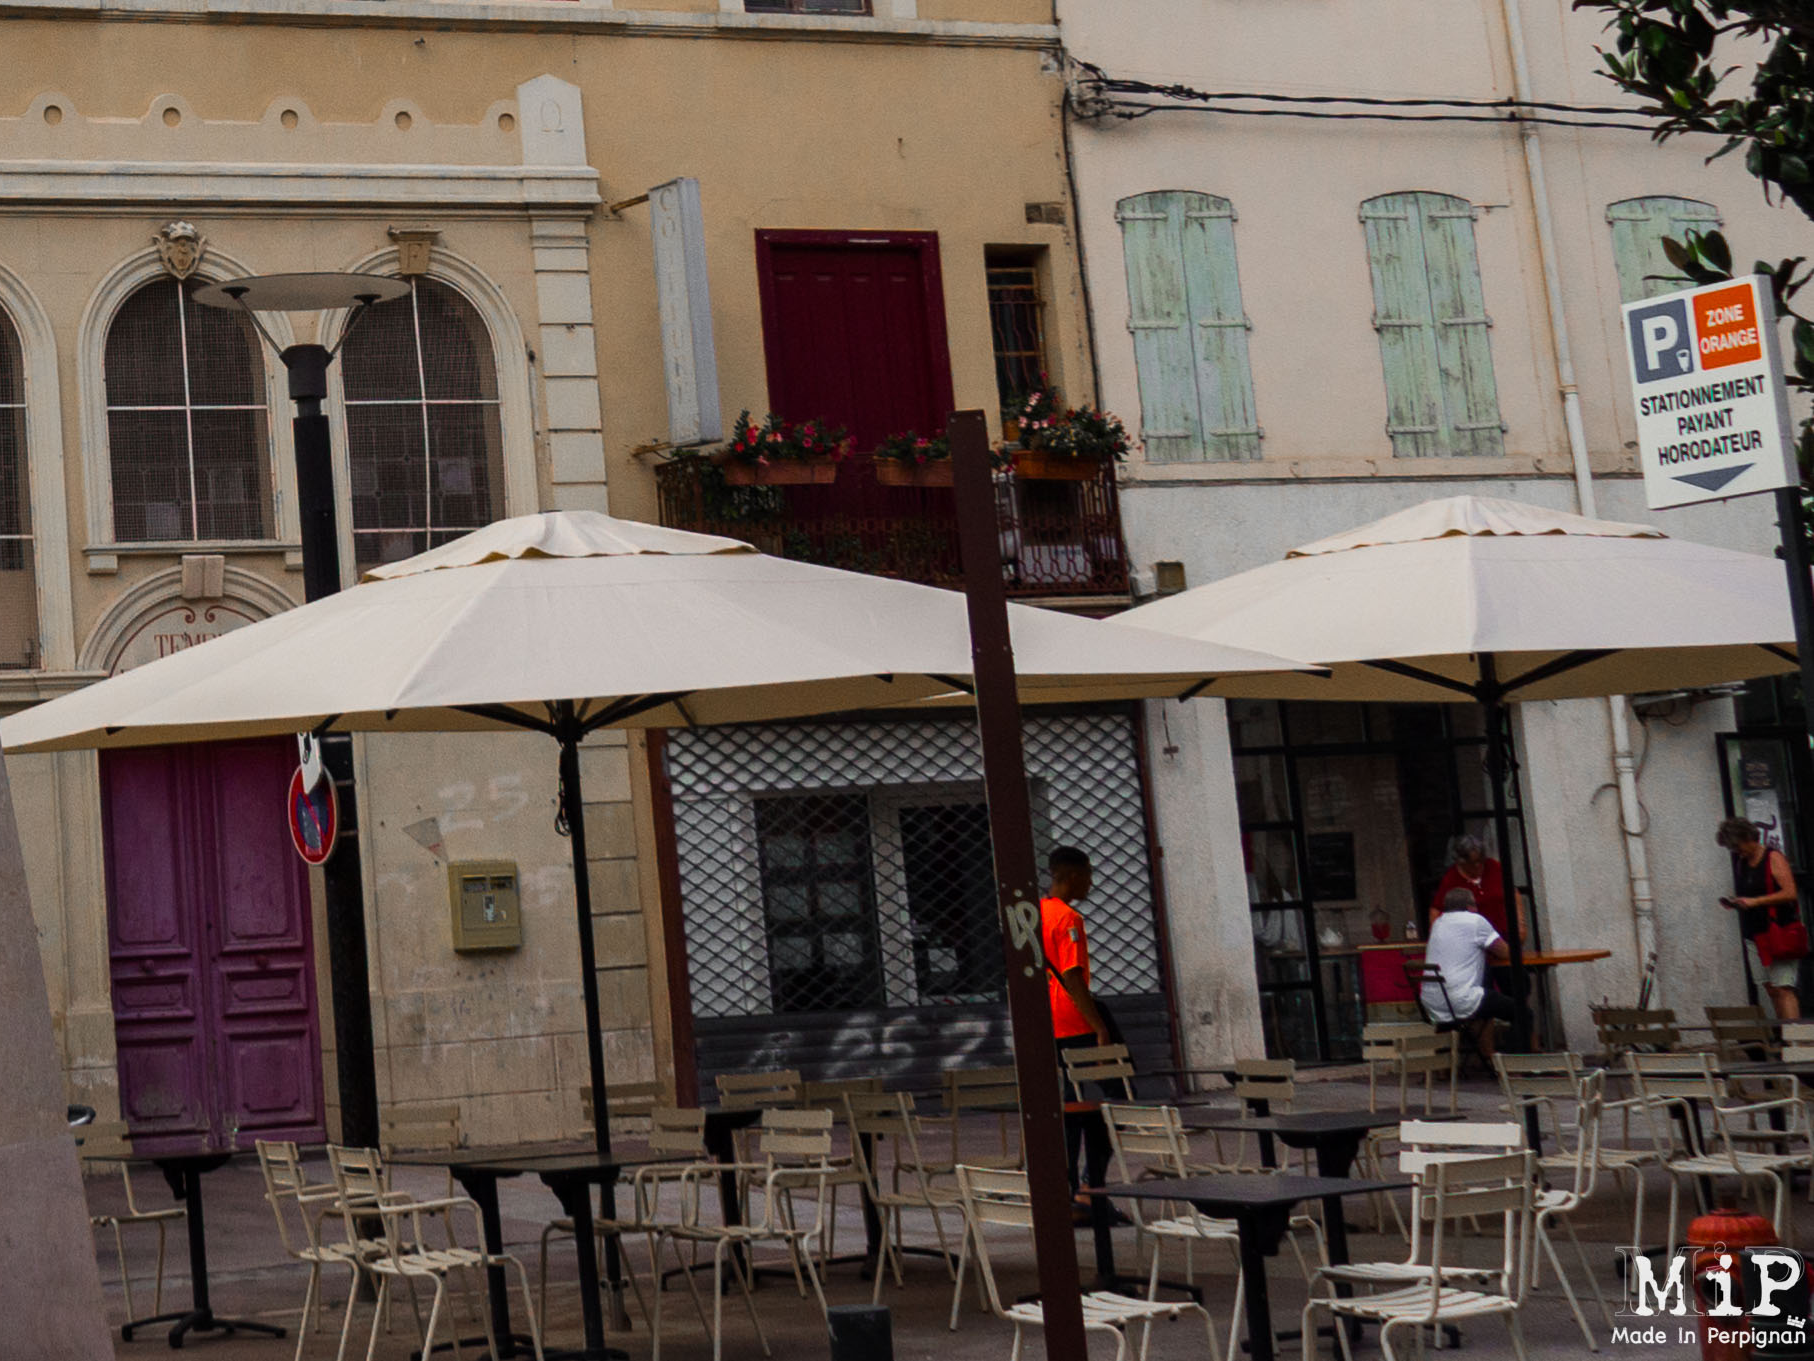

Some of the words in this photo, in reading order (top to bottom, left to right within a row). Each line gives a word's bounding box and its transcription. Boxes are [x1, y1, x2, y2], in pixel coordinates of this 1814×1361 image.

[1705, 304, 1744, 328] ZONE
[1641, 315, 1679, 371] P
[1700, 327, 1757, 354] ORANGE
[1640, 374, 1765, 416] STATIONNEMENT
[1677, 408, 1734, 436] PAYANT
[1658, 430, 1763, 466] HORODATEUR
